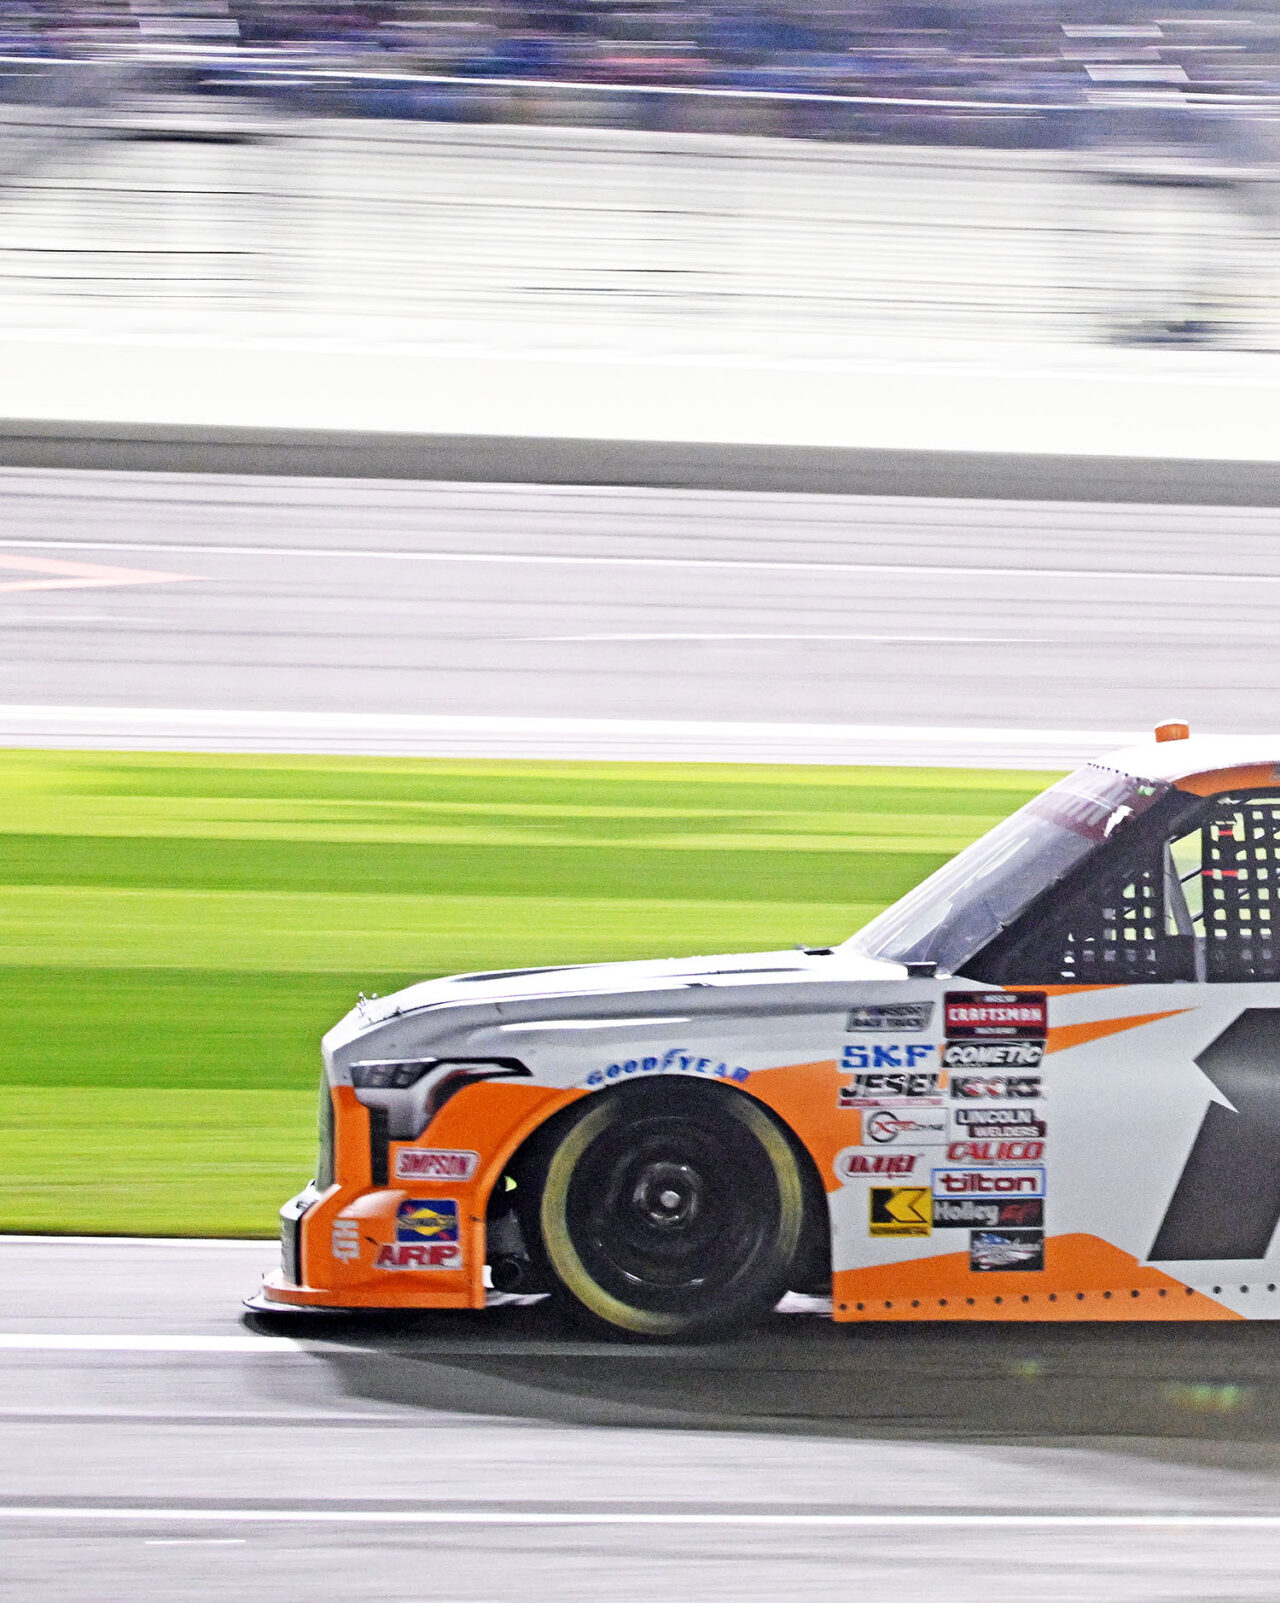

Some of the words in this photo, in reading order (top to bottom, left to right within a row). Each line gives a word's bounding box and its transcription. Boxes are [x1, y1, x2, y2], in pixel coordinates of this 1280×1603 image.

[948, 1008, 1042, 1022] CRAFTSMAN
[841, 1045, 934, 1068] SKF
[944, 1046, 1042, 1063] COMETIC
[958, 1110, 1031, 1123] LINCOLN
[948, 1142, 1044, 1160] CALICO
[940, 1173, 1036, 1192] tilton
[377, 1244, 460, 1266] ARP
